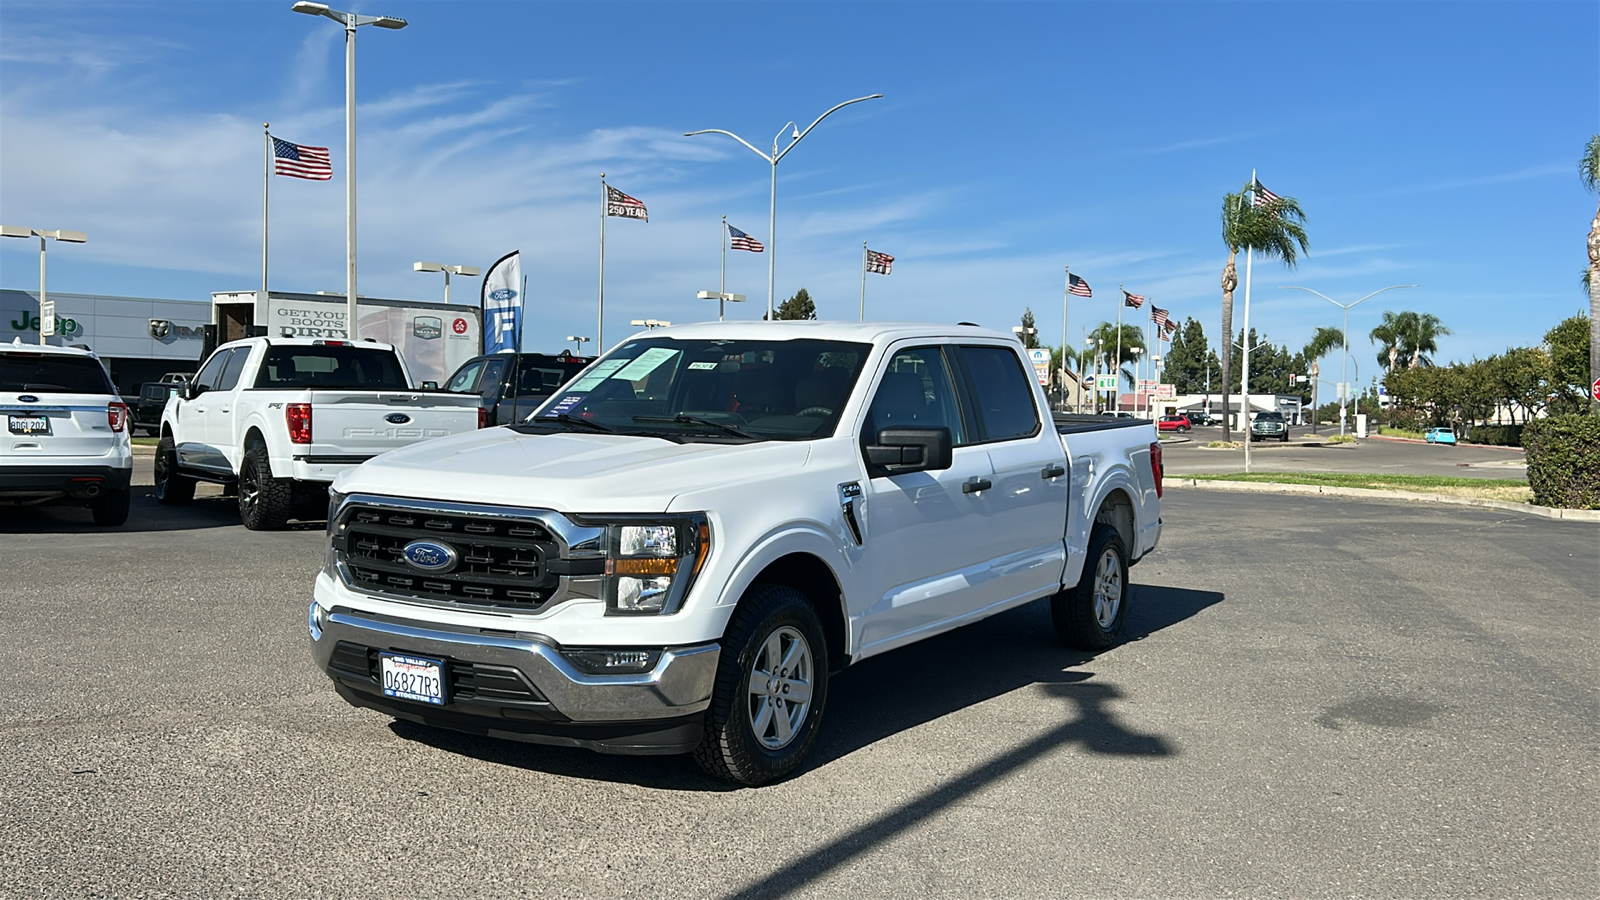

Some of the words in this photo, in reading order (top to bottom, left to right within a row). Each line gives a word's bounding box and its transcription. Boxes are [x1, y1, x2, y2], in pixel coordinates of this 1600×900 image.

[609, 204, 625, 215] 250
[494, 290, 513, 300] Ford
[277, 308, 311, 317] GET
[290, 318, 344, 329] BOOTS
[412, 547, 441, 564] Ford
[405, 658, 428, 666] VALLEY
[385, 670, 440, 697] 06827R3
[395, 692, 430, 703] STOCKTON
